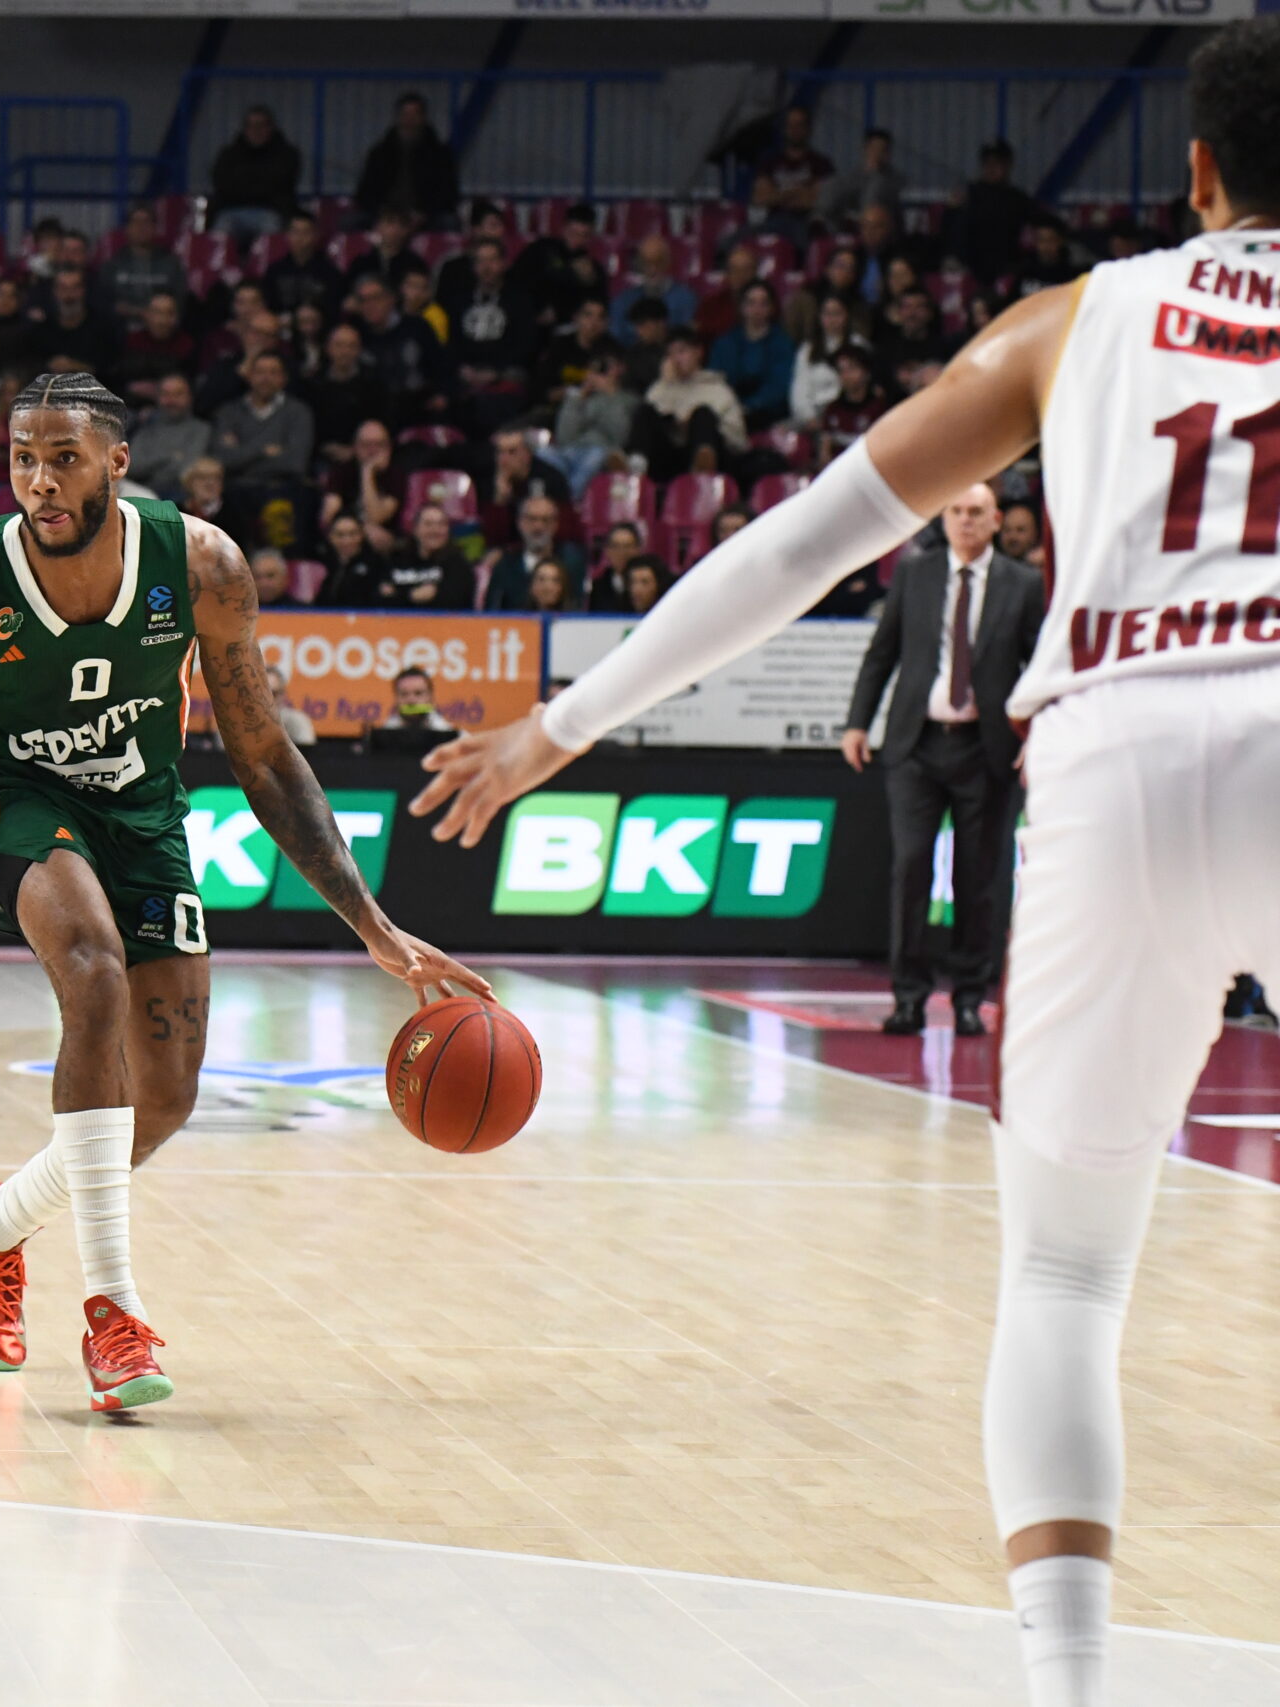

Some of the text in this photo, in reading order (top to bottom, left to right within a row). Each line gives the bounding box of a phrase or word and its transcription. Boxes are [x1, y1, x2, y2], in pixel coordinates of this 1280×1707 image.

[1188, 258, 1280, 309] ENN
[1153, 401, 1280, 556] 11
[147, 621, 176, 630] EuroCup
[69, 658, 112, 701] 0
[506, 814, 823, 896] BKT
[137, 930, 166, 940] EuroCup
[174, 893, 207, 954] 0
